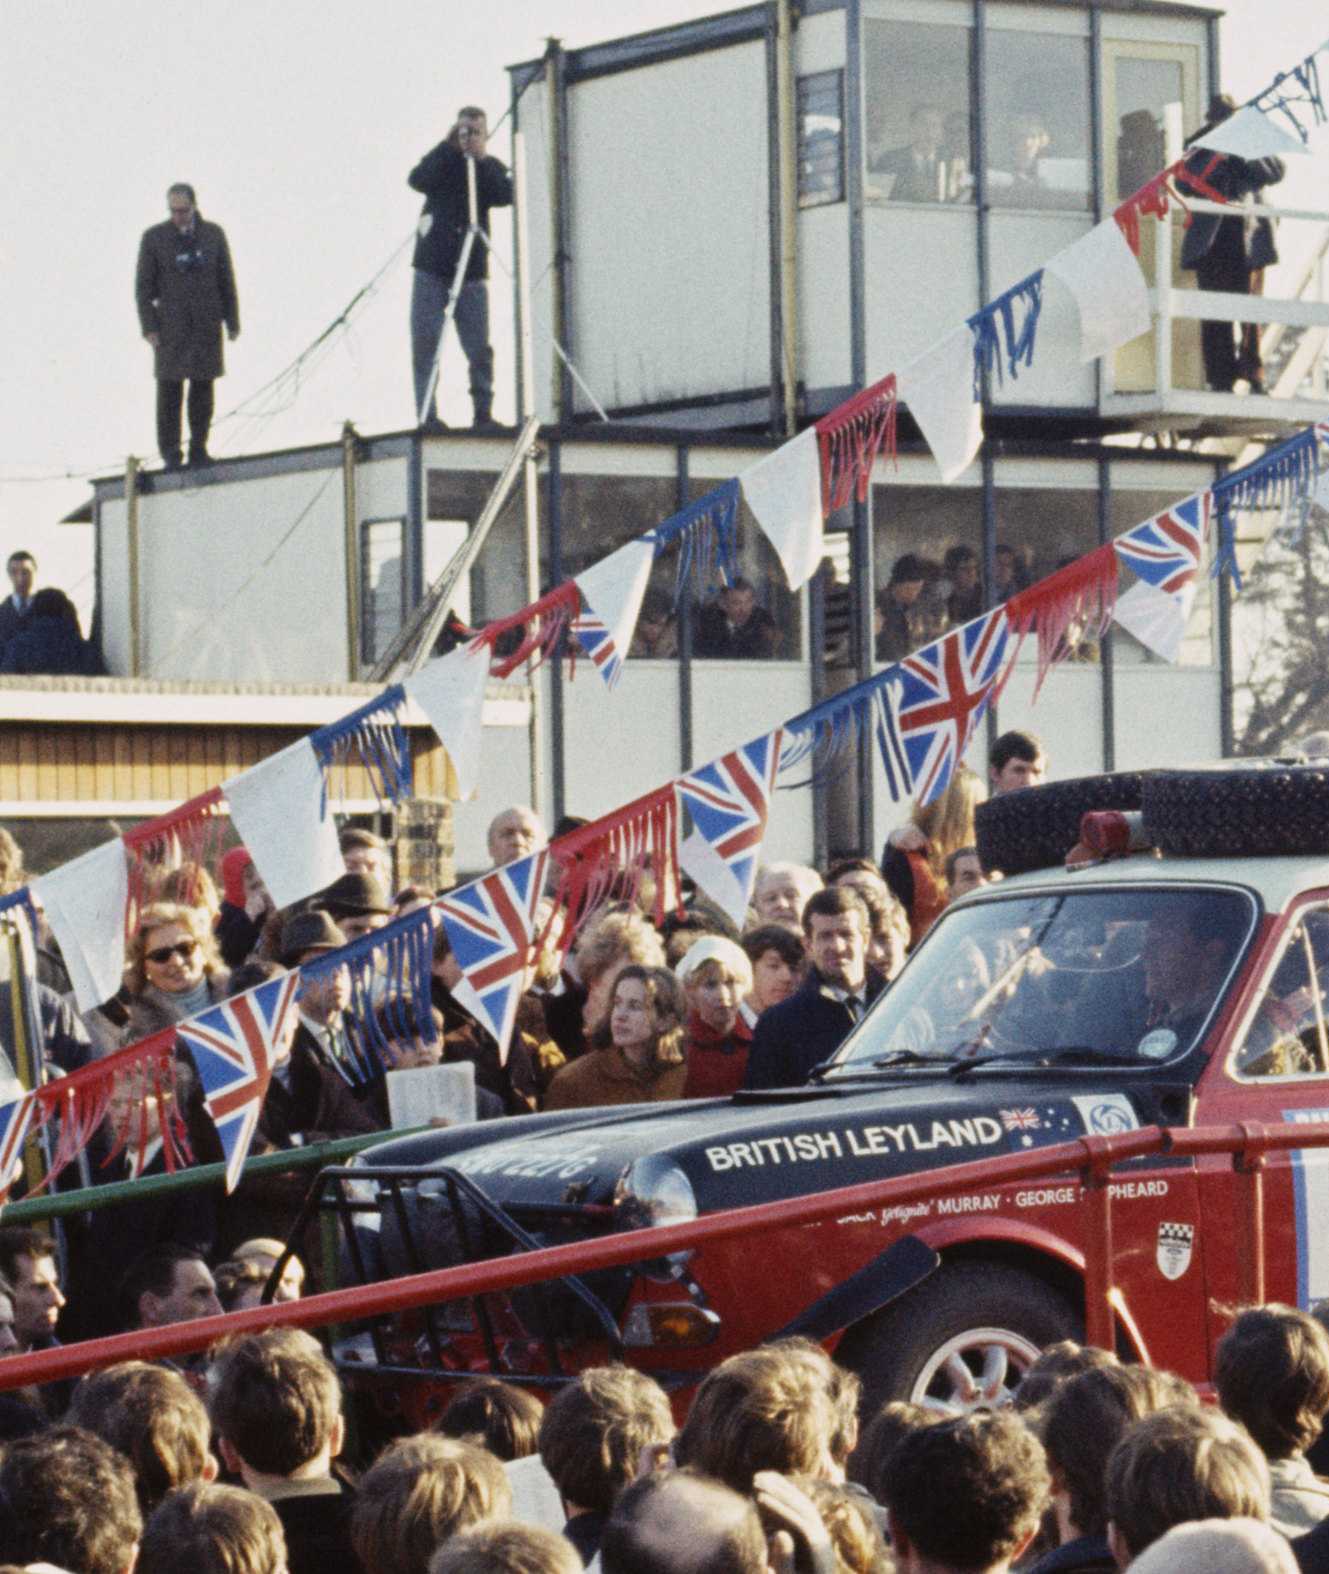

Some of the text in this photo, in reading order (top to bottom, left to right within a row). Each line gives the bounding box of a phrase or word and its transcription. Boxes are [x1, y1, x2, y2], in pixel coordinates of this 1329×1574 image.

[705, 1116, 1003, 1172] BRITISH LEYLAND
[937, 1195, 1000, 1214] MURRAY
[1015, 1188, 1075, 1207] GEORGE
